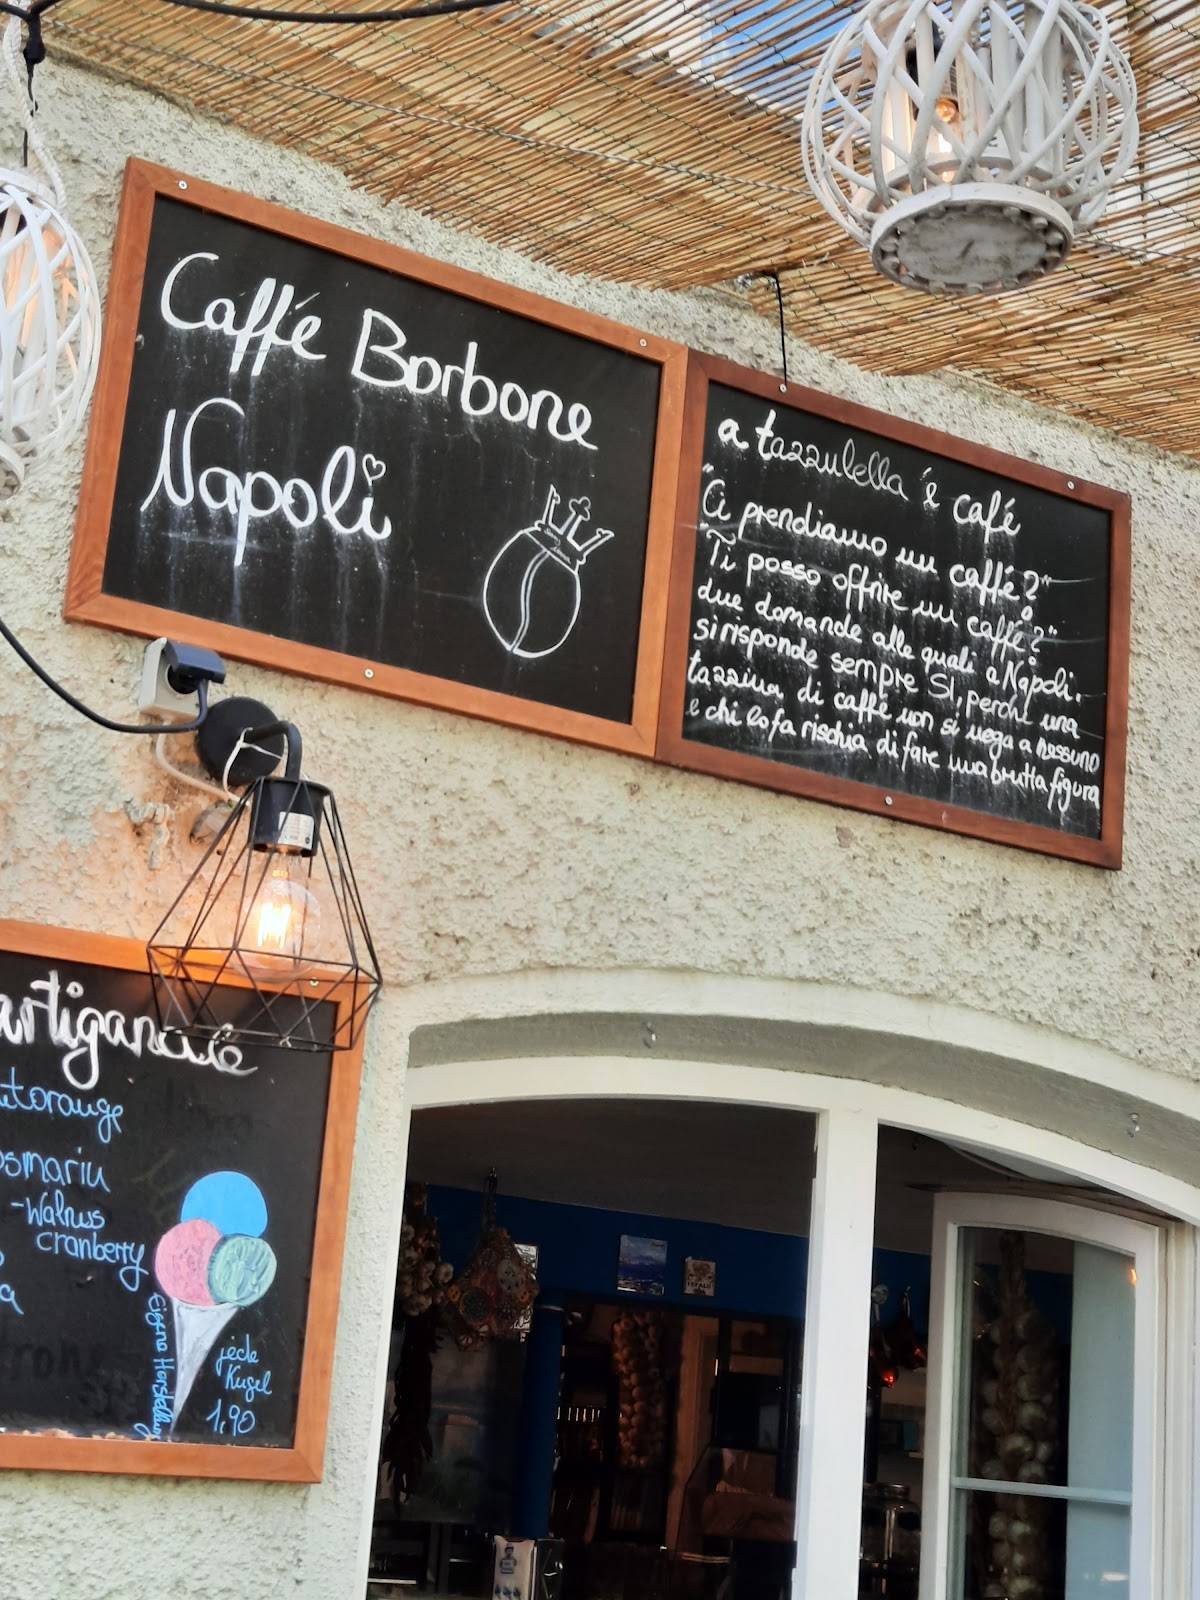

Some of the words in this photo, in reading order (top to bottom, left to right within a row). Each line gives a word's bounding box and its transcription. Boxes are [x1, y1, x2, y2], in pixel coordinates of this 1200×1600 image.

[351, 308, 600, 451] Borbone
[140, 396, 392, 566] Napoli
[717, 418, 750, 449] a
[755, 409, 909, 501] tazzulella
[738, 502, 887, 557] prendiamo
[746, 553, 821, 587] posso
[832, 563, 908, 612] offrire
[697, 577, 744, 612] due
[755, 591, 862, 644] domande
[872, 624, 915, 660] alle
[921, 646, 977, 675] quali
[986, 665, 1000, 686] a
[687, 649, 784, 700] tazzina
[797, 674, 824, 704] di
[896, 707, 934, 732] non
[940, 712, 961, 736] si
[965, 724, 1014, 761] nega
[1019, 739, 1033, 753] a
[831, 652, 919, 699] sempre
[1039, 713, 1080, 739] una
[685, 698, 700, 716] e
[705, 696, 742, 727] chi
[801, 714, 870, 755] rischia
[876, 729, 899, 758] di
[990, 758, 1049, 792] brutta
[1047, 767, 1101, 814] figura
[215, 1333, 259, 1377] jede
[225, 1364, 273, 1403] Kugel
